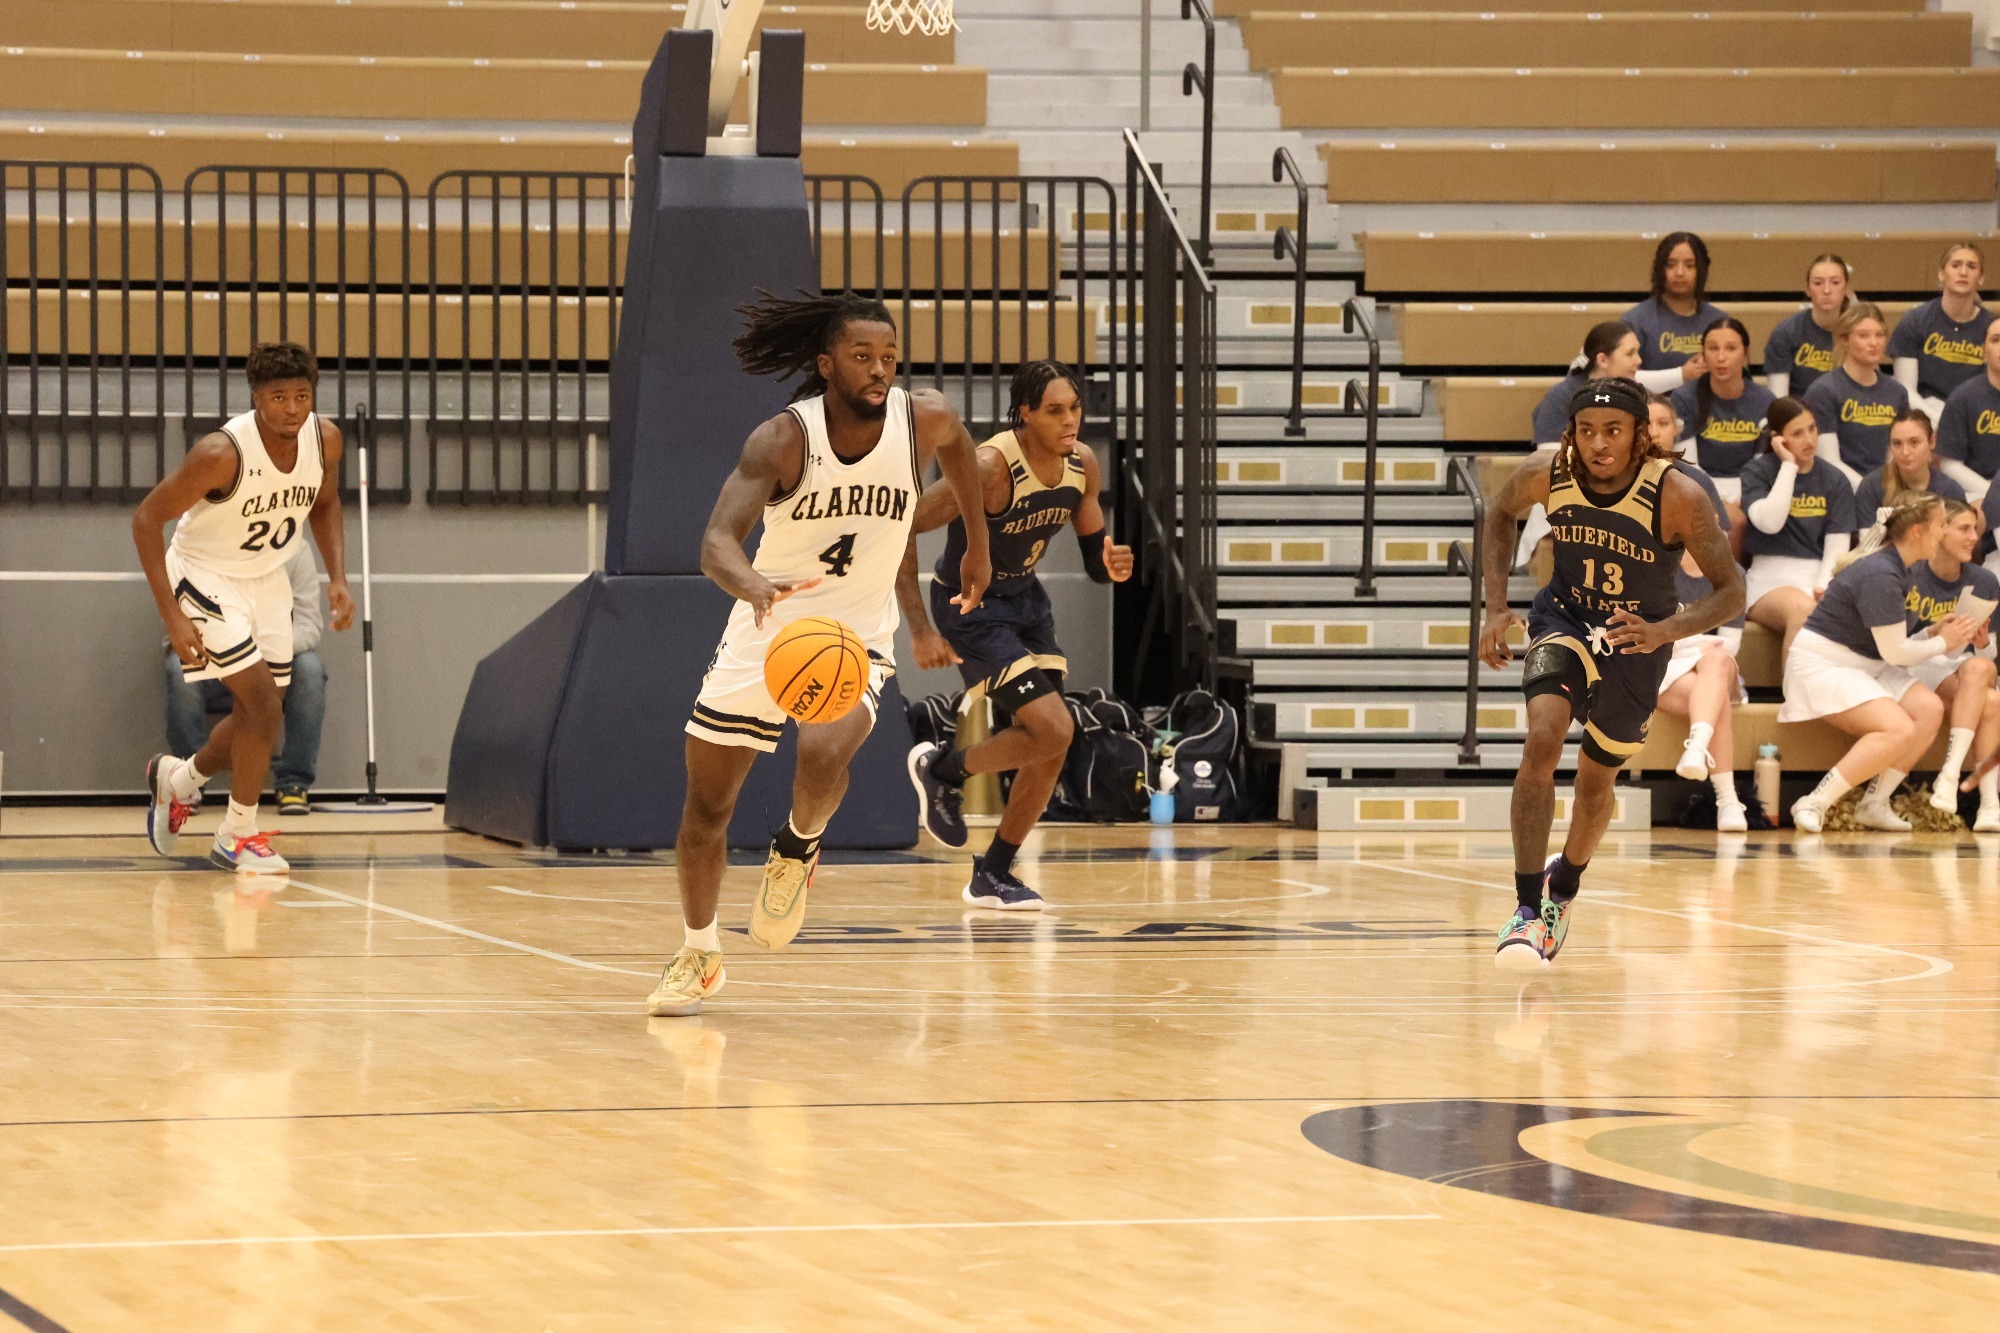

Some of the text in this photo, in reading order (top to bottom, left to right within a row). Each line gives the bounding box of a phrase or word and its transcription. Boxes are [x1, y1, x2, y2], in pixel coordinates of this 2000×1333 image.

[1795, 342, 1832, 366] Clar
[1924, 332, 1983, 358] Clarion
[1841, 398, 1897, 422] Clarion
[1705, 416, 1757, 434] larion
[241, 486, 317, 518] CLARION
[791, 484, 909, 522] CLARION
[1791, 492, 1827, 508] rion
[240, 516, 297, 552] 20
[1001, 507, 1071, 534] BLUEFIE
[819, 532, 860, 577] 4
[1023, 539, 1045, 567] 3
[1552, 525, 1655, 563] BLUEFIELD
[1582, 558, 1624, 596] 13
[1919, 596, 1958, 621] Clari
[790, 677, 825, 716] NCAA
